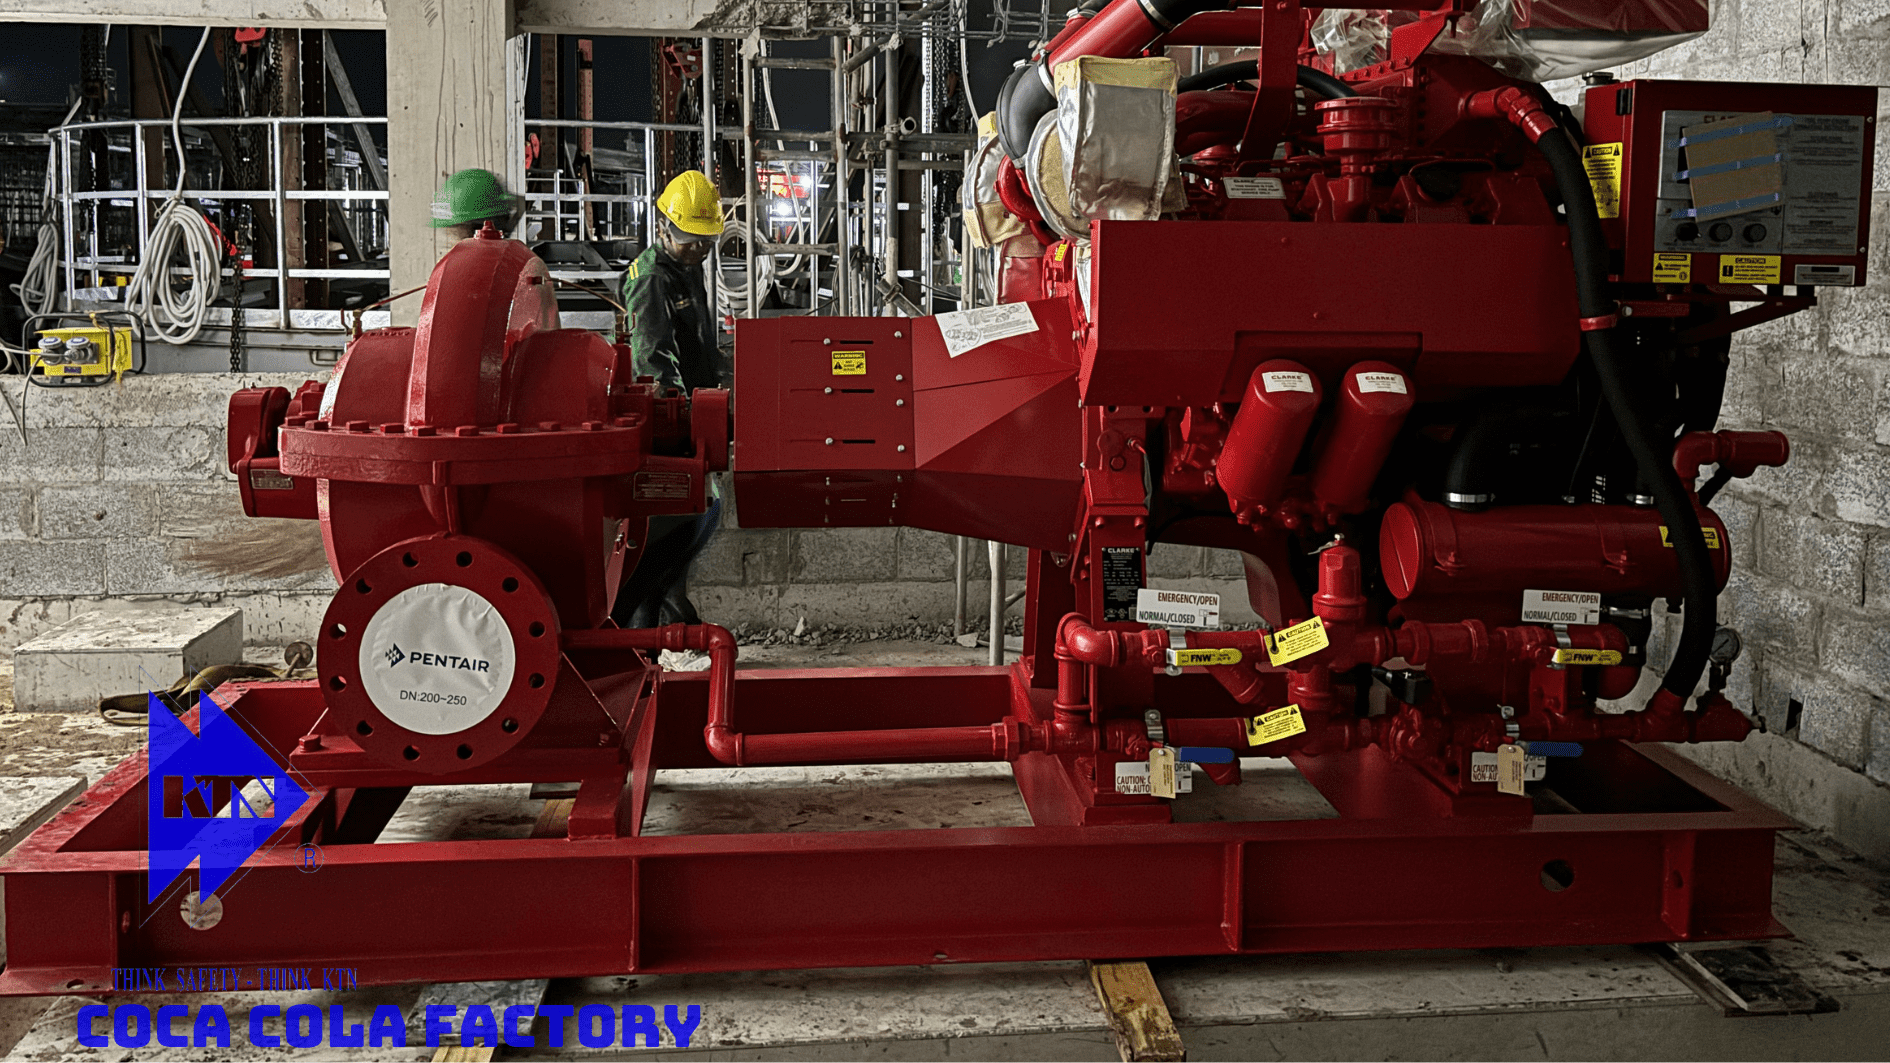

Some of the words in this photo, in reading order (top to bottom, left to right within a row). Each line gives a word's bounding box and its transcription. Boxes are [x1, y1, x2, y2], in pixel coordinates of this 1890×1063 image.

[1157, 592, 1218, 606] EMERGENCY/OPEN
[1542, 592, 1599, 604] EMERGENCY/OPEN
[1138, 610, 1196, 624] NORMAL/CLOSED
[1523, 610, 1577, 622] NORMAL/CLOSED
[409, 651, 490, 673] PENTAIR
[1190, 654, 1212, 662] FNW
[1573, 653, 1594, 661] FNW
[399, 690, 468, 706] DN:200~250
[1116, 775, 1147, 785] CAUTION:
[1116, 784, 1151, 794] NON-AUTO
